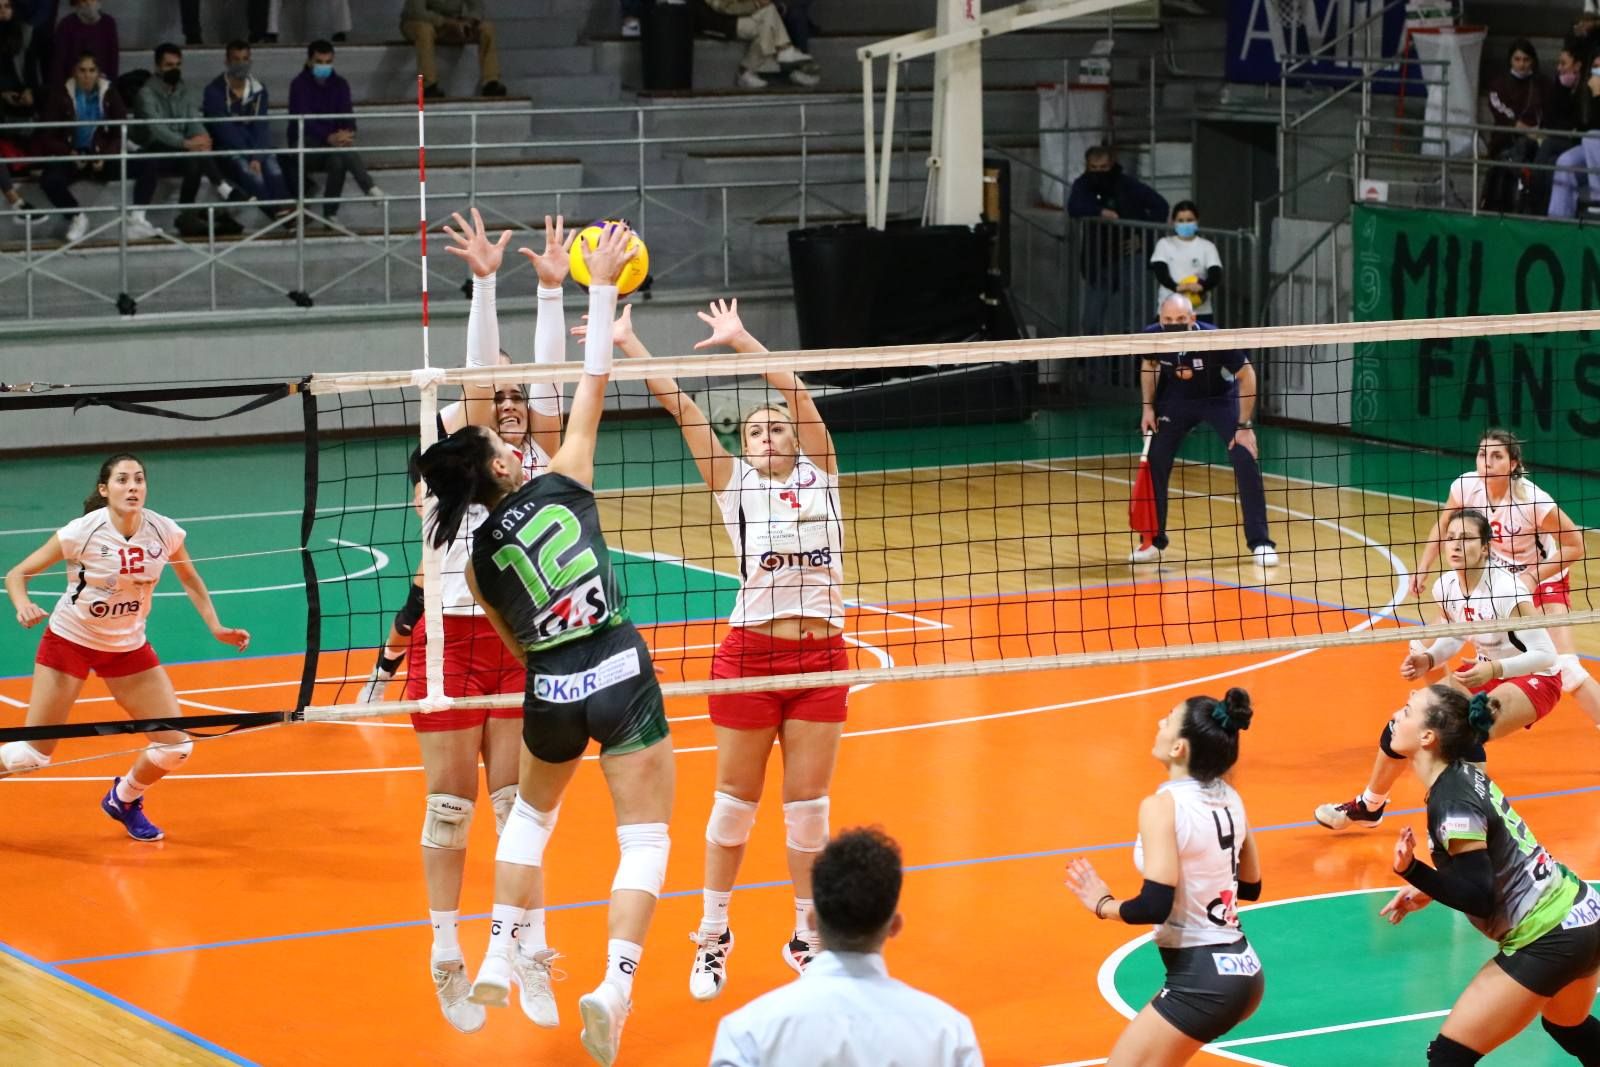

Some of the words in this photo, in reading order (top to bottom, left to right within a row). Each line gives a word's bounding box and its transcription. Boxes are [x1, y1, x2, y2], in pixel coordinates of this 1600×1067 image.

[118, 547, 145, 575] 12
[491, 503, 599, 609] 12
[1212, 806, 1238, 877] 4
